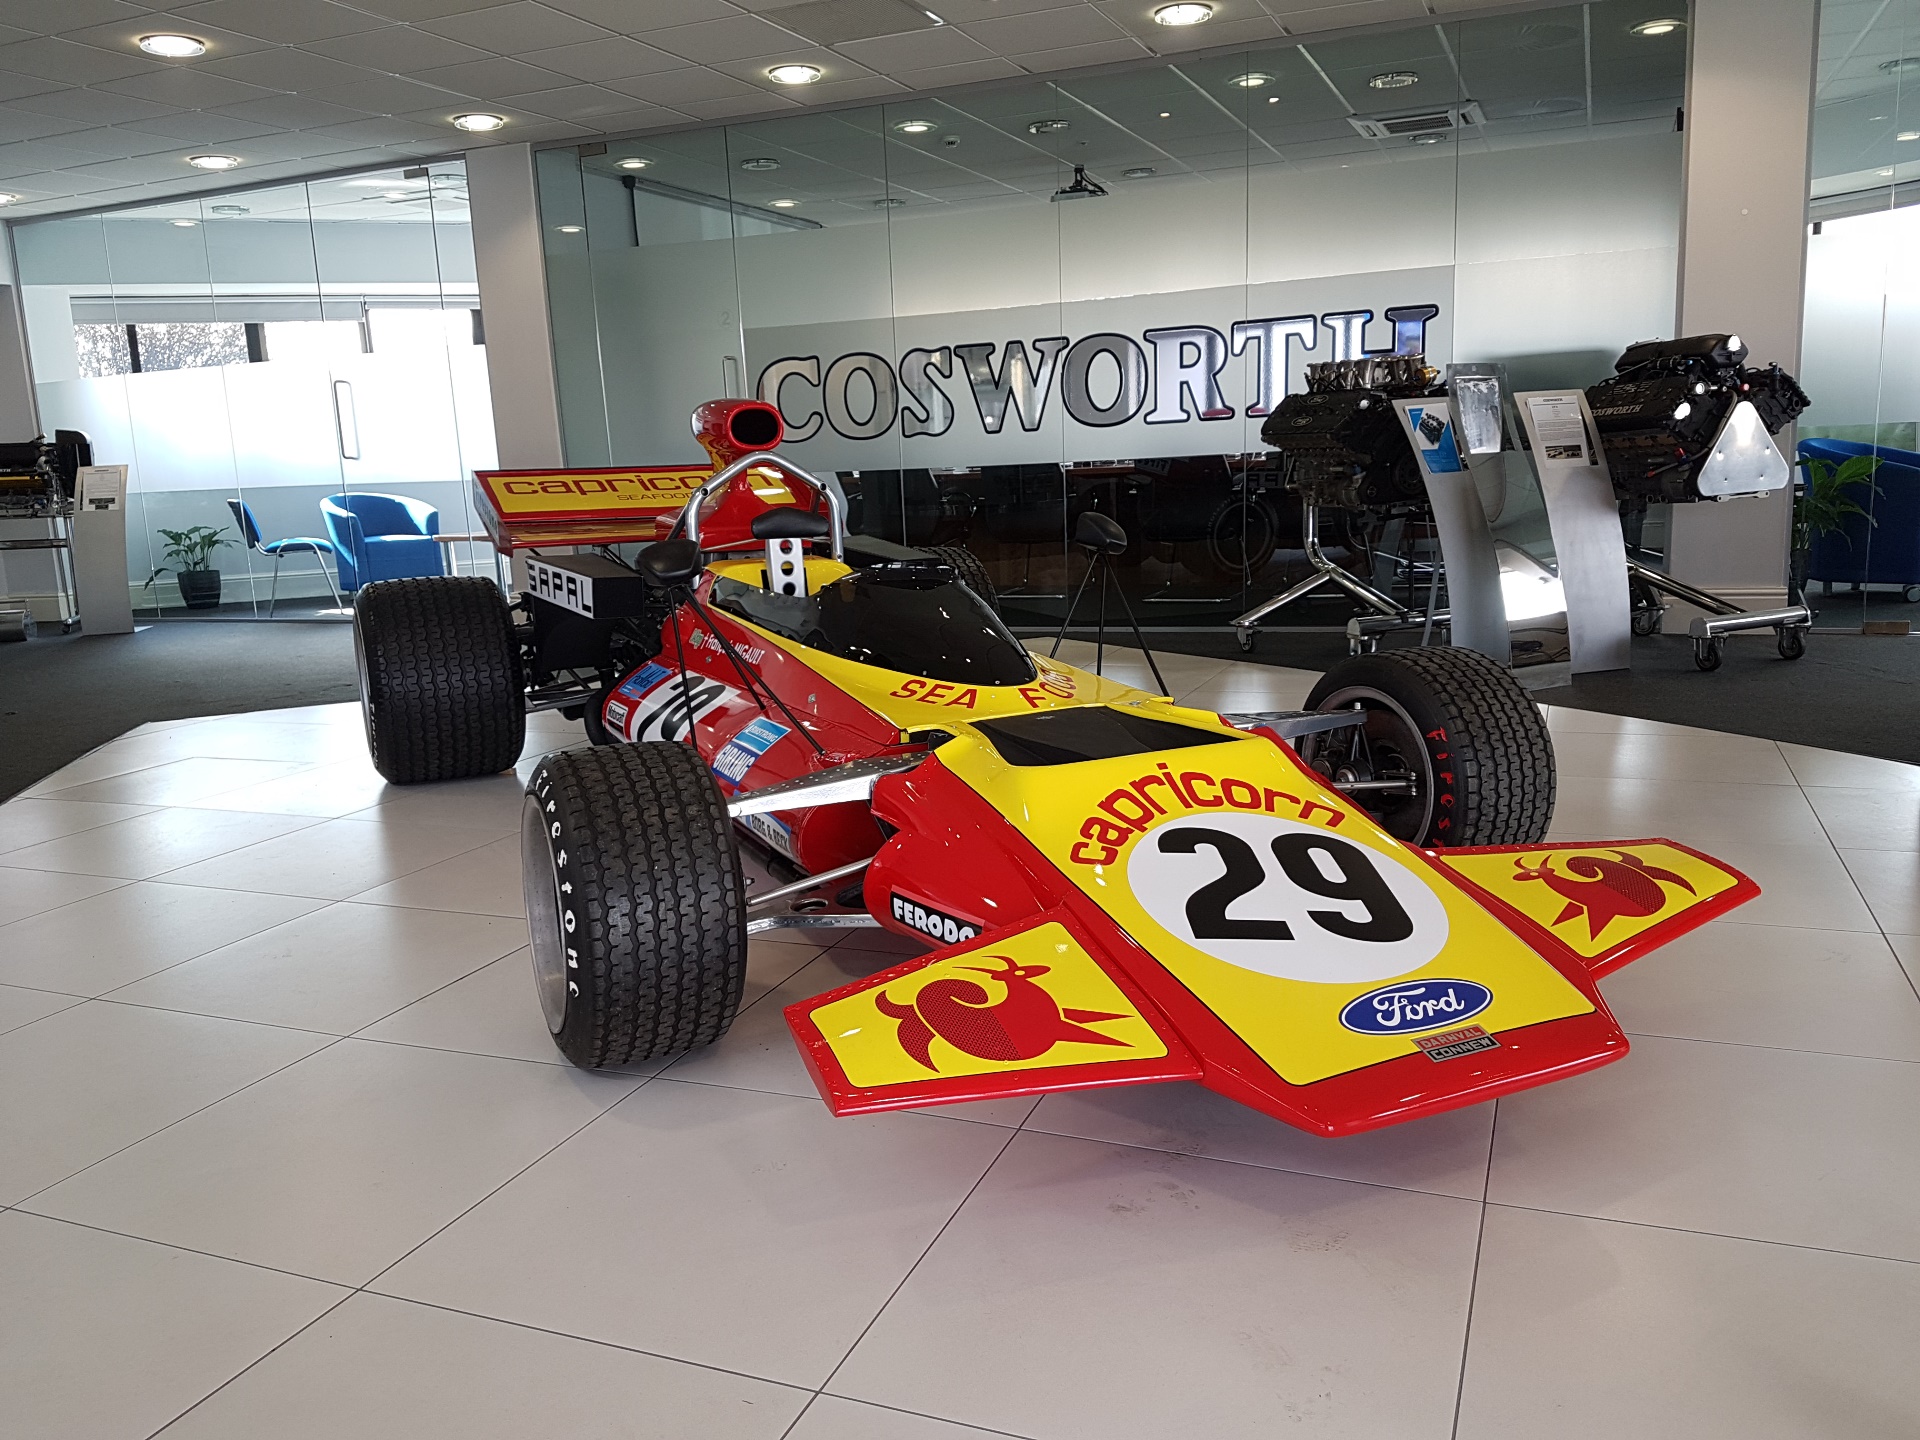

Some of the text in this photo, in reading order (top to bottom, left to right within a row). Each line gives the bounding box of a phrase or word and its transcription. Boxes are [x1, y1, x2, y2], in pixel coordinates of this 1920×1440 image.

[757, 304, 1439, 443] COSWORTH
[890, 679, 977, 709] SEA
[712, 744, 756, 782] GIRLING
[1070, 762, 1346, 866] capricorn
[1157, 826, 1414, 943] 29
[893, 897, 976, 943] FERODO
[1372, 987, 1466, 1026] Ford
[1418, 1027, 1483, 1049] DARNVAL
[1430, 1037, 1493, 1060] CONNEW
